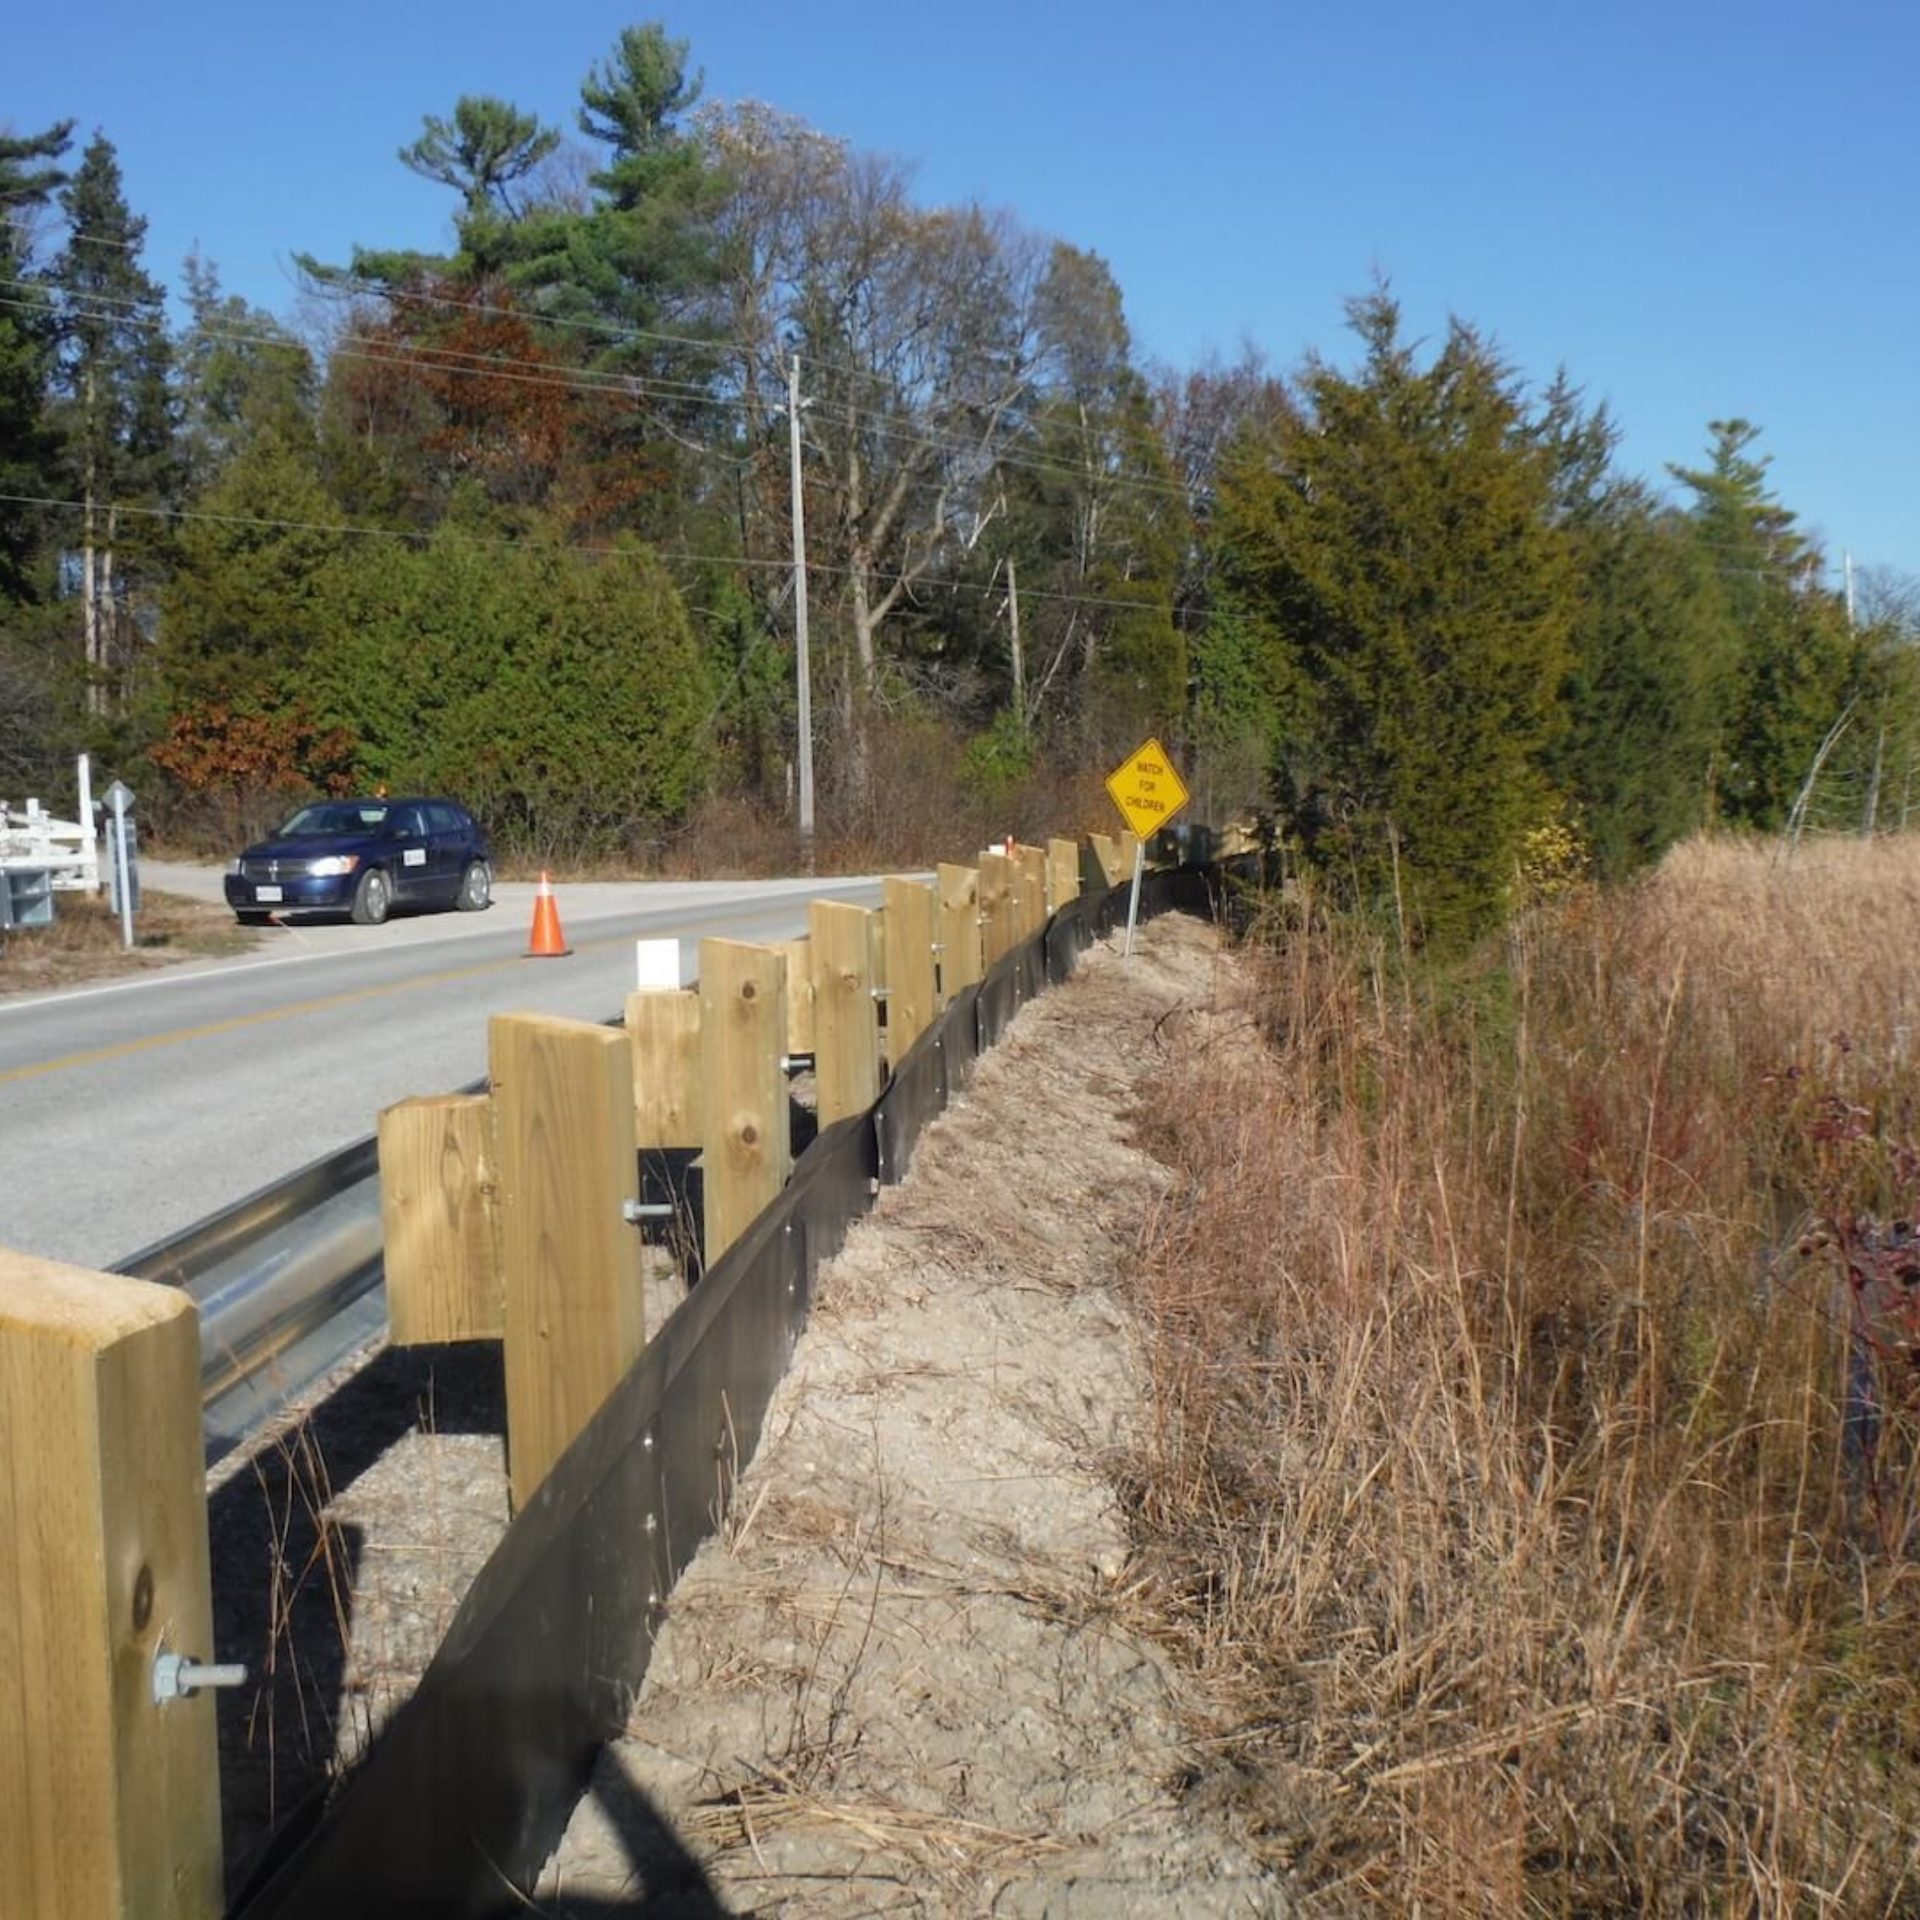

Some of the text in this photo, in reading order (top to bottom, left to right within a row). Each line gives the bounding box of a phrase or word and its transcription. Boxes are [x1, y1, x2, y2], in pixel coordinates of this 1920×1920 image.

[1136, 762, 1163, 775] WATCH
[1139, 780, 1155, 792] FOR
[1125, 796, 1165, 812] CHILDREN
